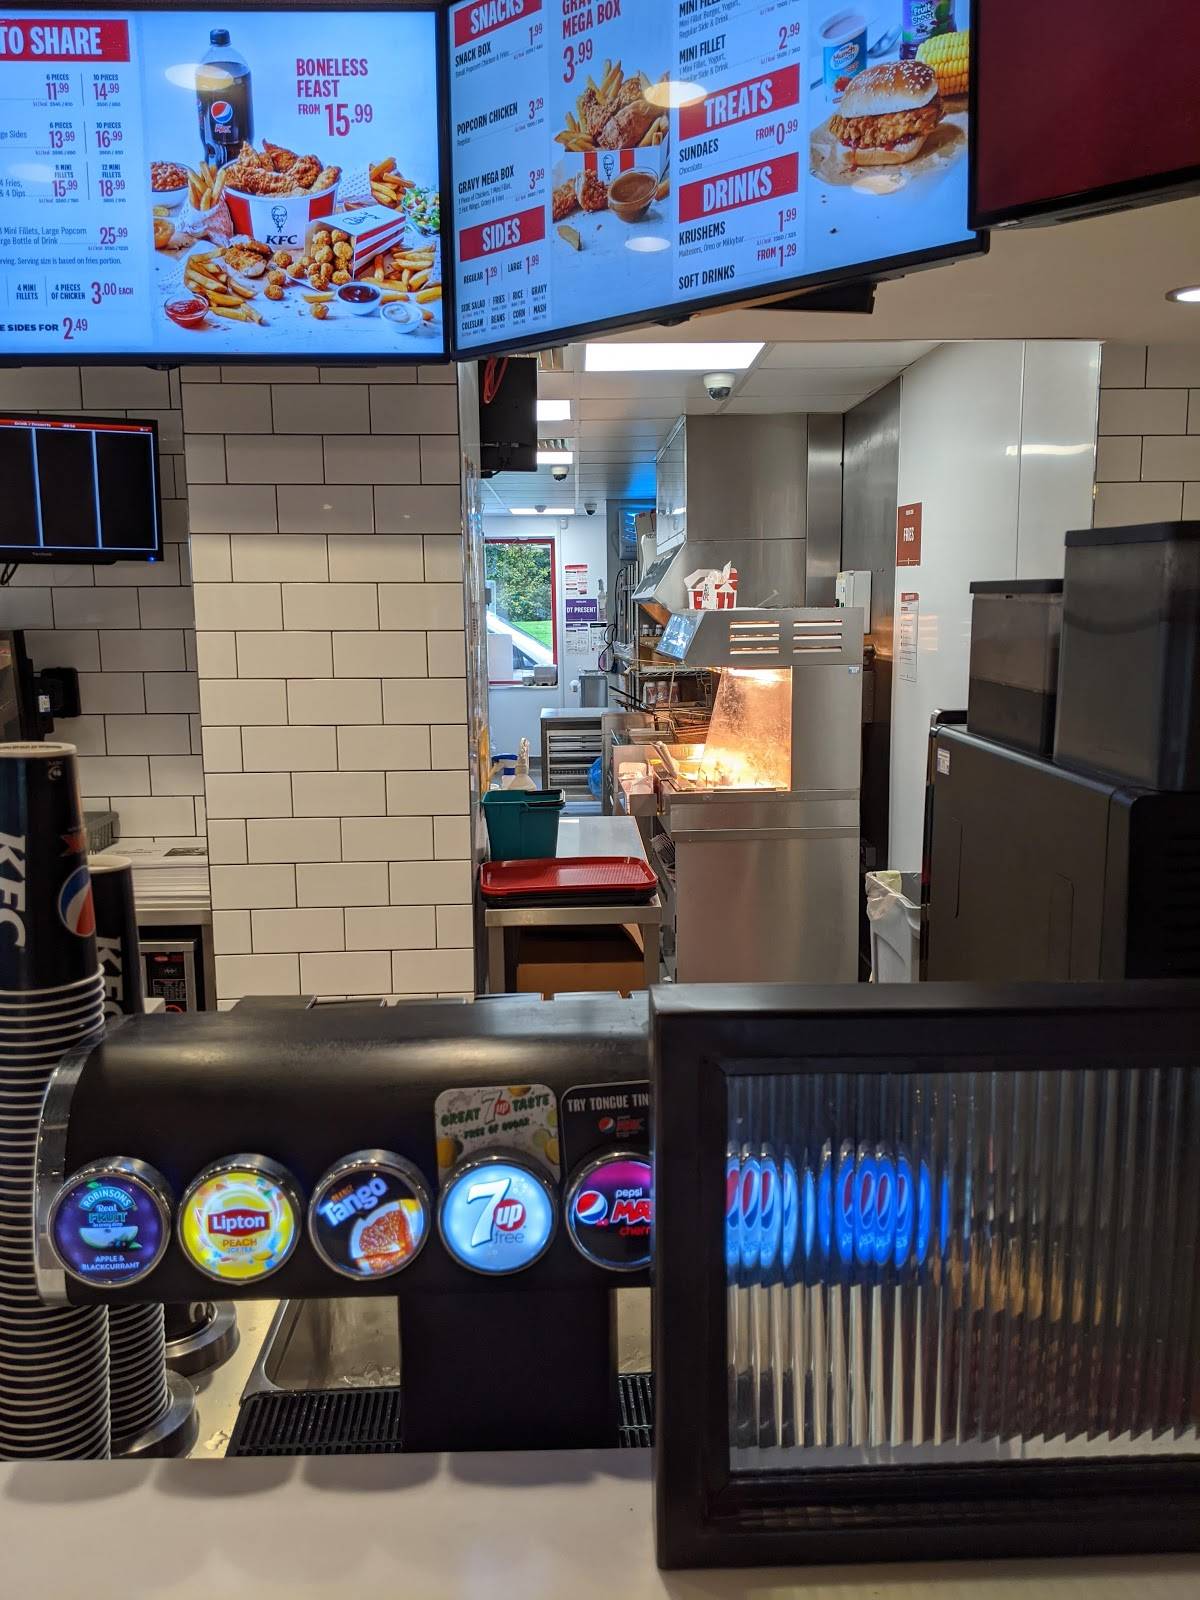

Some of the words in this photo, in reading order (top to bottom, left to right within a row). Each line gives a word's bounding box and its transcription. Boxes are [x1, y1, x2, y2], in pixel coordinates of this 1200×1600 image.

[470, 0, 524, 34] SNACKS
[562, 0, 597, 15] GRA
[679, 0, 698, 18] MINI
[913, 4, 931, 15] Fruit
[563, 9, 593, 40] MEGA
[597, 0, 621, 25] BOX
[912, 13, 934, 25] Shoot
[0, 26, 24, 54] TO
[30, 26, 102, 55] SHARE
[778, 22, 800, 50] 2.99
[455, 48, 477, 68] SNACK
[478, 41, 492, 58] BOX
[679, 45, 698, 65] MINI
[699, 33, 726, 57] FILLET
[296, 58, 369, 77] BONELESS
[563, 38, 593, 84] 3.99
[45, 82, 70, 101] 11.99
[93, 82, 120, 101] 14.99
[297, 79, 340, 98] FEAST
[704, 78, 773, 128] TREATS
[298, 103, 321, 115] FROM
[324, 103, 373, 137] 15.99
[457, 113, 488, 136] POPCORN
[489, 102, 518, 124] CHICKEN
[9, 130, 28, 139] Sides
[49, 130, 76, 149] 13.99
[96, 130, 123, 149] 16.99
[755, 124, 775, 141] FROM
[776, 119, 798, 145] 0.99
[679, 138, 719, 162] SUNDAES
[54, 171, 74, 179] FILLETS
[102, 171, 122, 179] FILLETS
[458, 176, 480, 194] GRAVY
[481, 169, 500, 187] MEGA
[500, 164, 515, 180] BOX
[529, 168, 545, 190] 3.99
[11, 190, 26, 199] Dips
[52, 180, 79, 198] 15.99
[99, 180, 126, 198] 18.99
[703, 165, 773, 213] DRINKS
[778, 208, 797, 233] 1.99
[12, 236, 33, 245] Bottle
[33, 236, 40, 245] of
[41, 236, 58, 245] Drink
[42, 226, 59, 237] Large
[61, 226, 88, 237] Popcorn
[99, 226, 128, 245] 25.99
[266, 234, 297, 246] KFC
[482, 217, 521, 252] SIDES
[679, 220, 726, 246] KRUSHEMS
[17, 256, 39, 267] Serving
[58, 256, 76, 265] based
[76, 257, 85, 265] on
[85, 256, 99, 265] fries
[100, 257, 122, 267] portion.
[757, 246, 777, 262] FROM
[778, 243, 797, 268] 1.29
[507, 261, 522, 273] LARGE
[463, 271, 484, 285] REGULAR
[678, 272, 700, 290] SOFT
[702, 264, 735, 285] DRINKS
[16, 292, 39, 300] FILLETS
[22, 284, 37, 292] MINI
[51, 292, 59, 300] OF
[60, 292, 86, 301] CHICKEN
[60, 284, 81, 292] PIECES
[91, 281, 117, 305] 3.00
[118, 287, 134, 296] EACH
[512, 290, 524, 300] RICE
[7, 324, 37, 332] SIDES
[38, 324, 59, 332] FOR
[62, 317, 88, 340] 2.49
[903, 526, 915, 543] FRIES
[441, 1108, 481, 1127] GREAT
[511, 1094, 550, 1112] TASTE
[567, 1098, 586, 1113] TRY
[590, 1095, 630, 1111] TONGUE
[632, 1093, 649, 1107] TIN
[464, 1126, 486, 1139] FREE
[82, 1189, 132, 1208] ROBINSONS
[316, 1177, 388, 1226] Tango
[615, 1187, 643, 1199] pepsi
[96, 1203, 118, 1212] Real
[466, 1177, 511, 1248] 7
[610, 1198, 652, 1225] MA
[88, 1211, 128, 1224] FRUIT
[212, 1215, 266, 1233] Lipton
[494, 1231, 524, 1244] free
[618, 1226, 651, 1237] cherr
[223, 1238, 257, 1248] PEACH
[82, 1262, 140, 1271] BLACKCURRANT
[95, 1255, 117, 1263] APPLE
